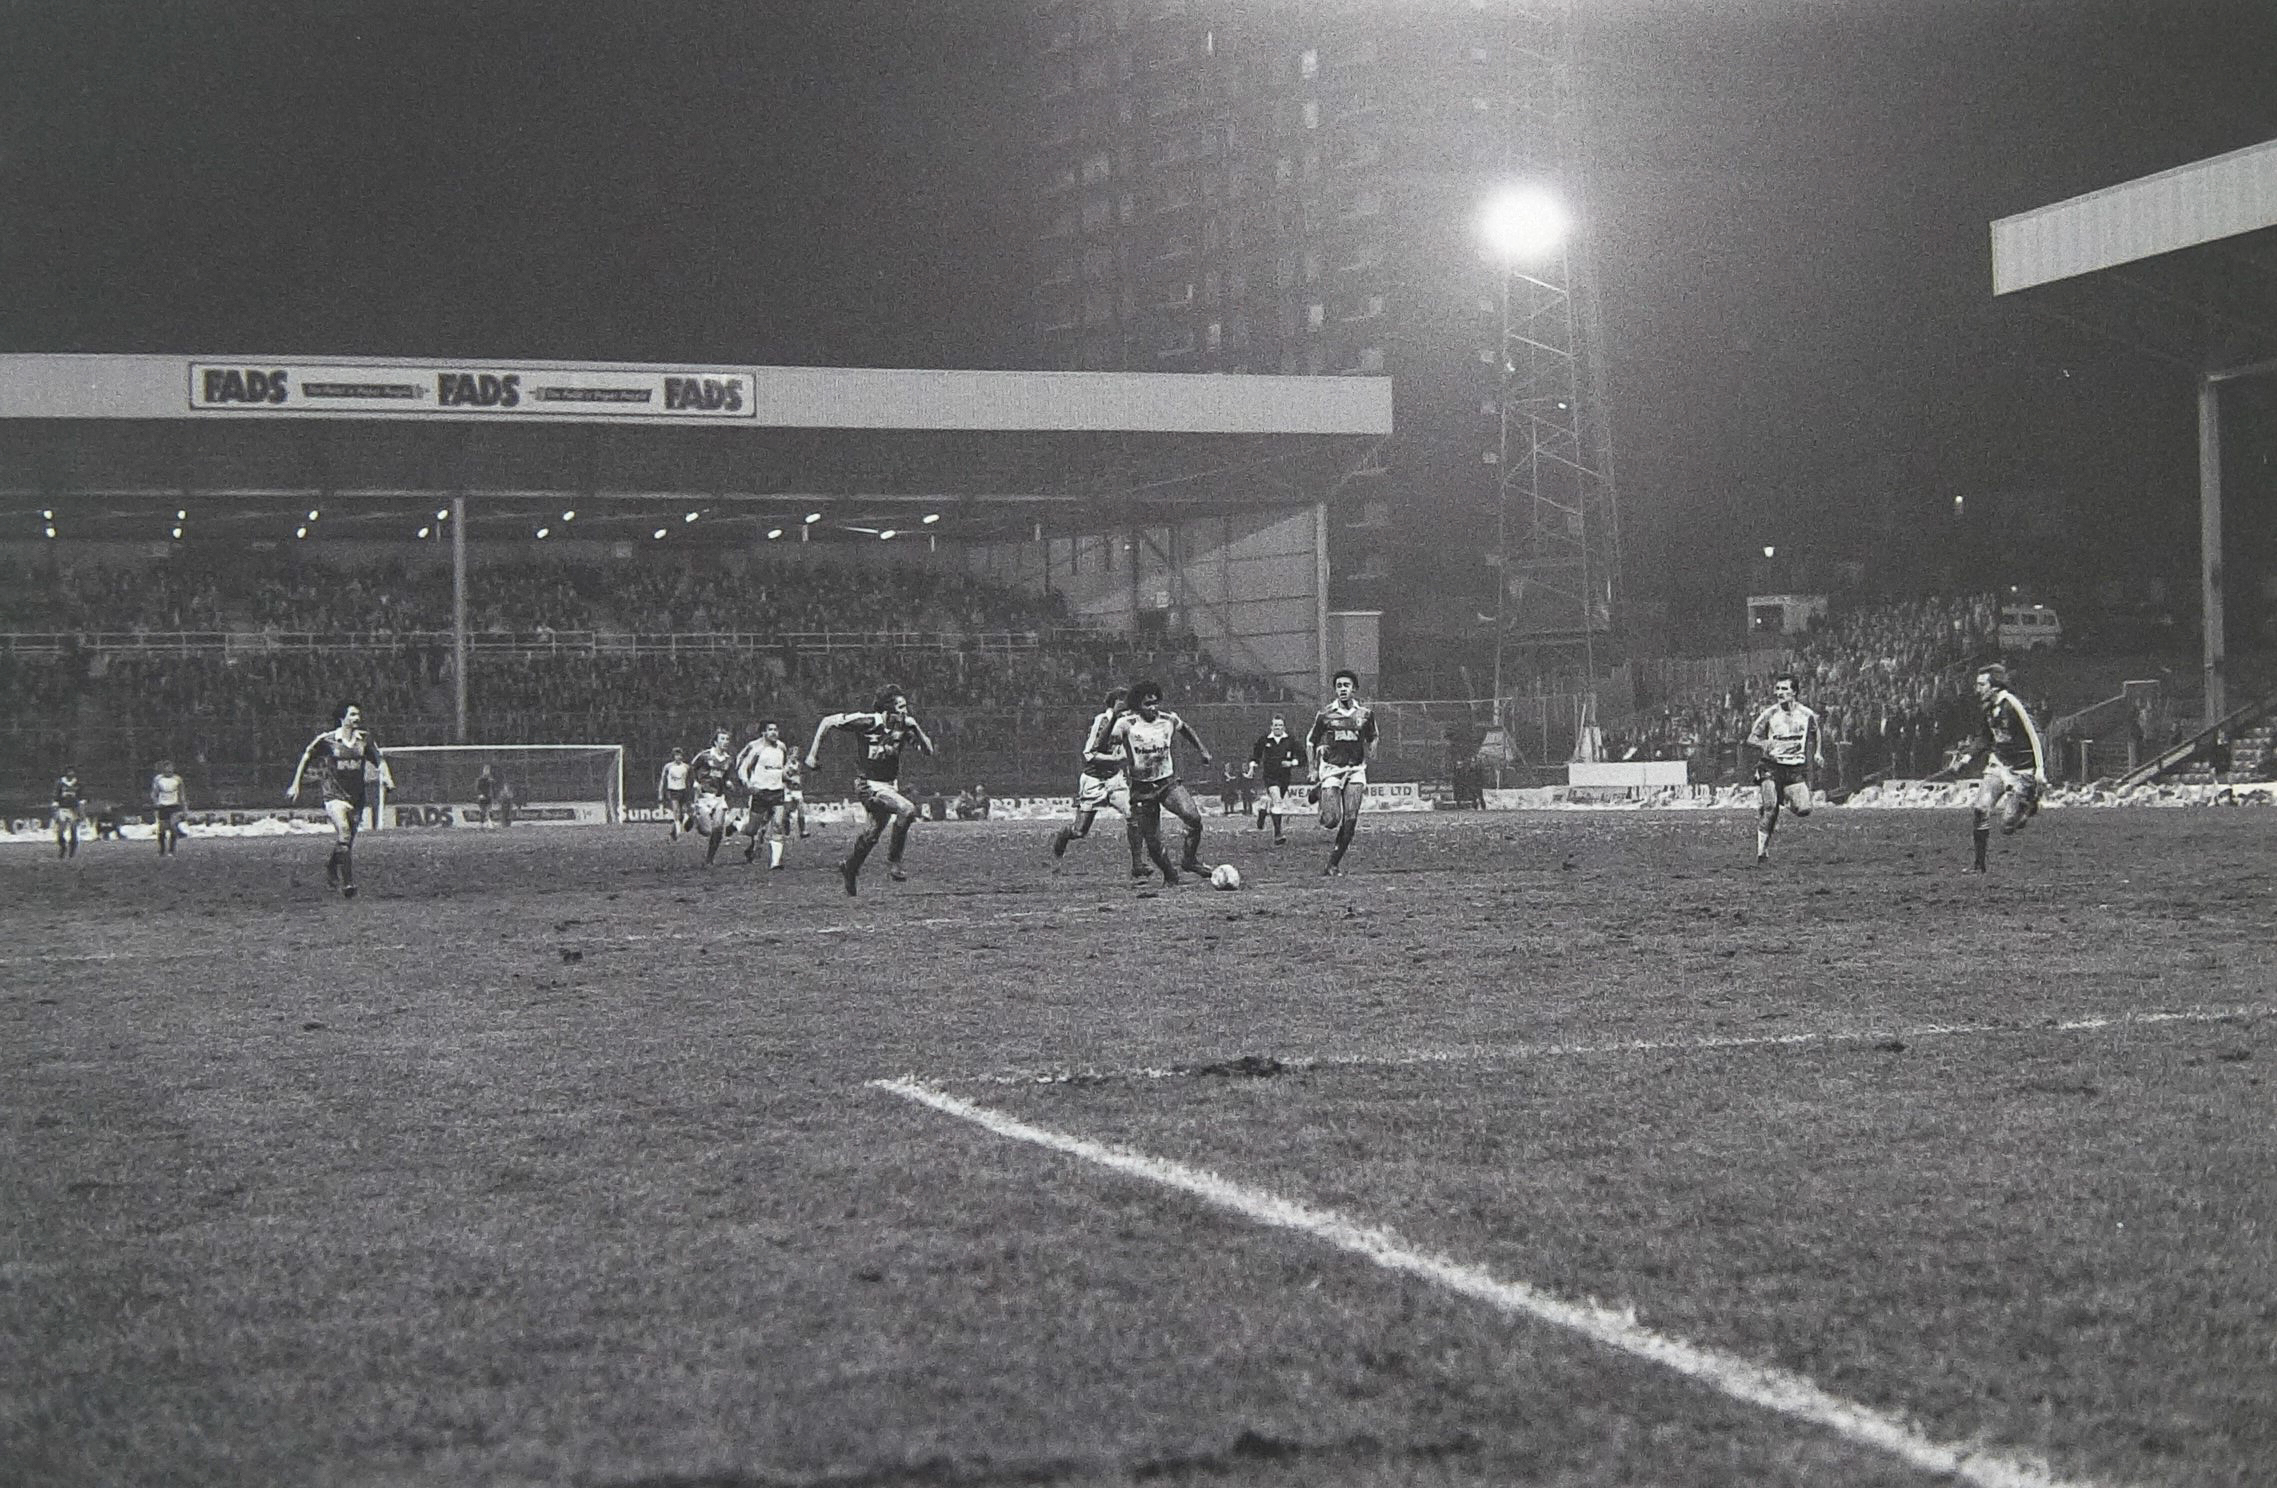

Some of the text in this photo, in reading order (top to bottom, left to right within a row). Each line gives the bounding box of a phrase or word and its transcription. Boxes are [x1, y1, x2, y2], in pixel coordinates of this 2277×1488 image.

[204, 369, 288, 404] FADS
[438, 373, 520, 407] FADS
[665, 377, 743, 411] FADS
[1390, 786, 1412, 797] LTD
[395, 806, 454, 828] FADS
